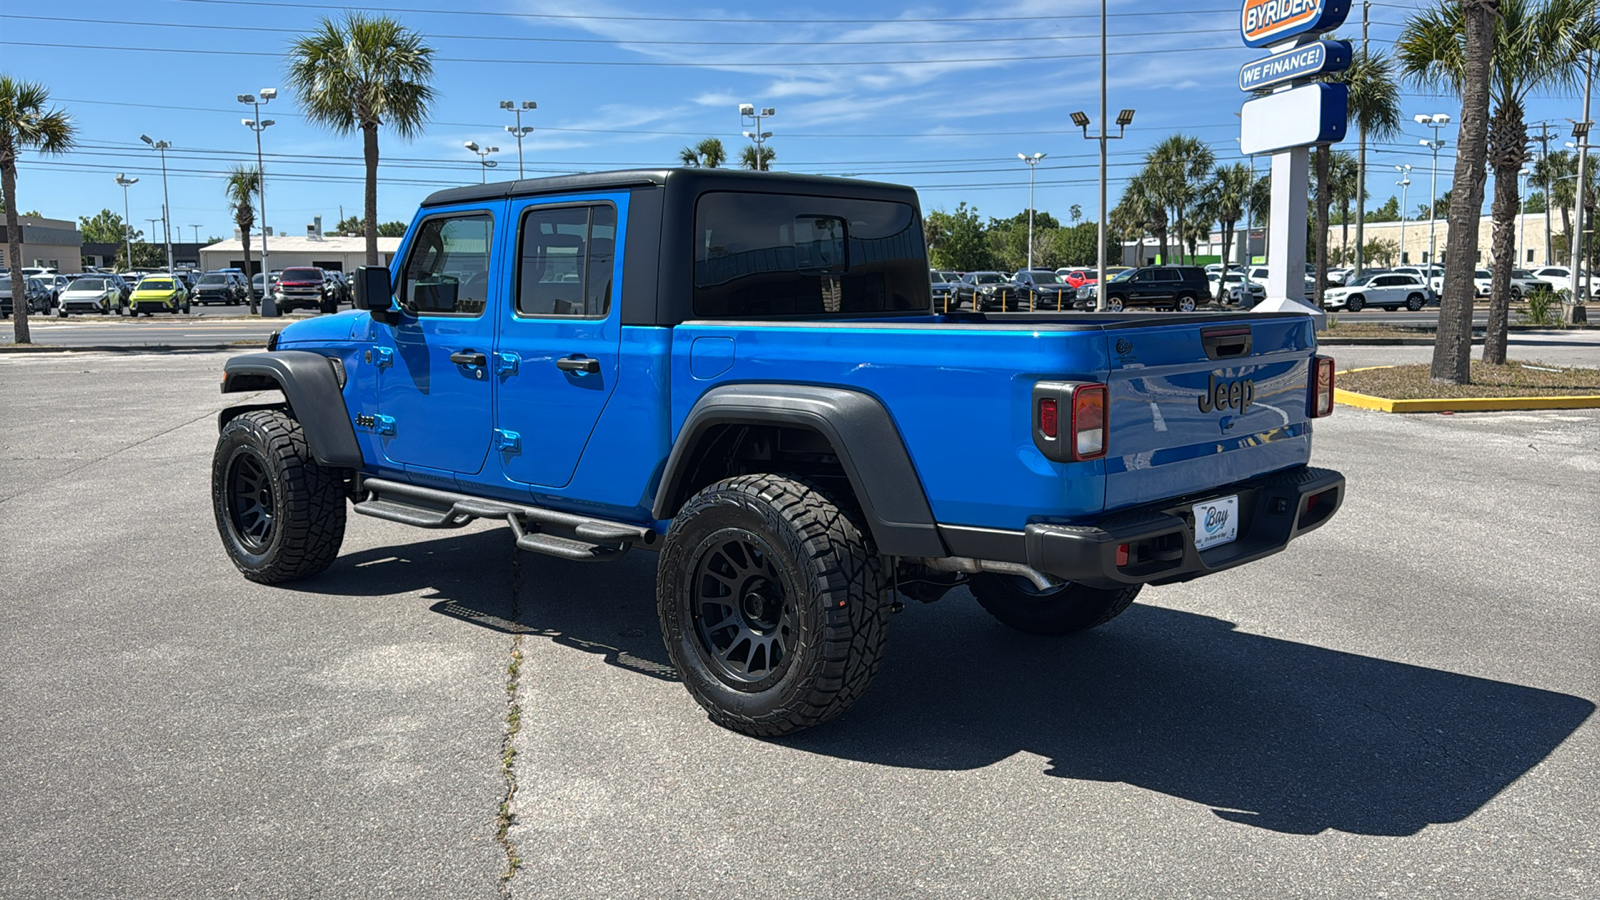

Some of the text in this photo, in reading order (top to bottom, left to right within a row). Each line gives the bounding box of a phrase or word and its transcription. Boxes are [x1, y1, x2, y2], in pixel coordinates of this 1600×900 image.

[1243, 49, 1320, 84] WE FINANCE!
[1198, 374, 1255, 414] Jeep
[355, 412, 374, 429] Jeep
[1206, 505, 1229, 527] Bay
